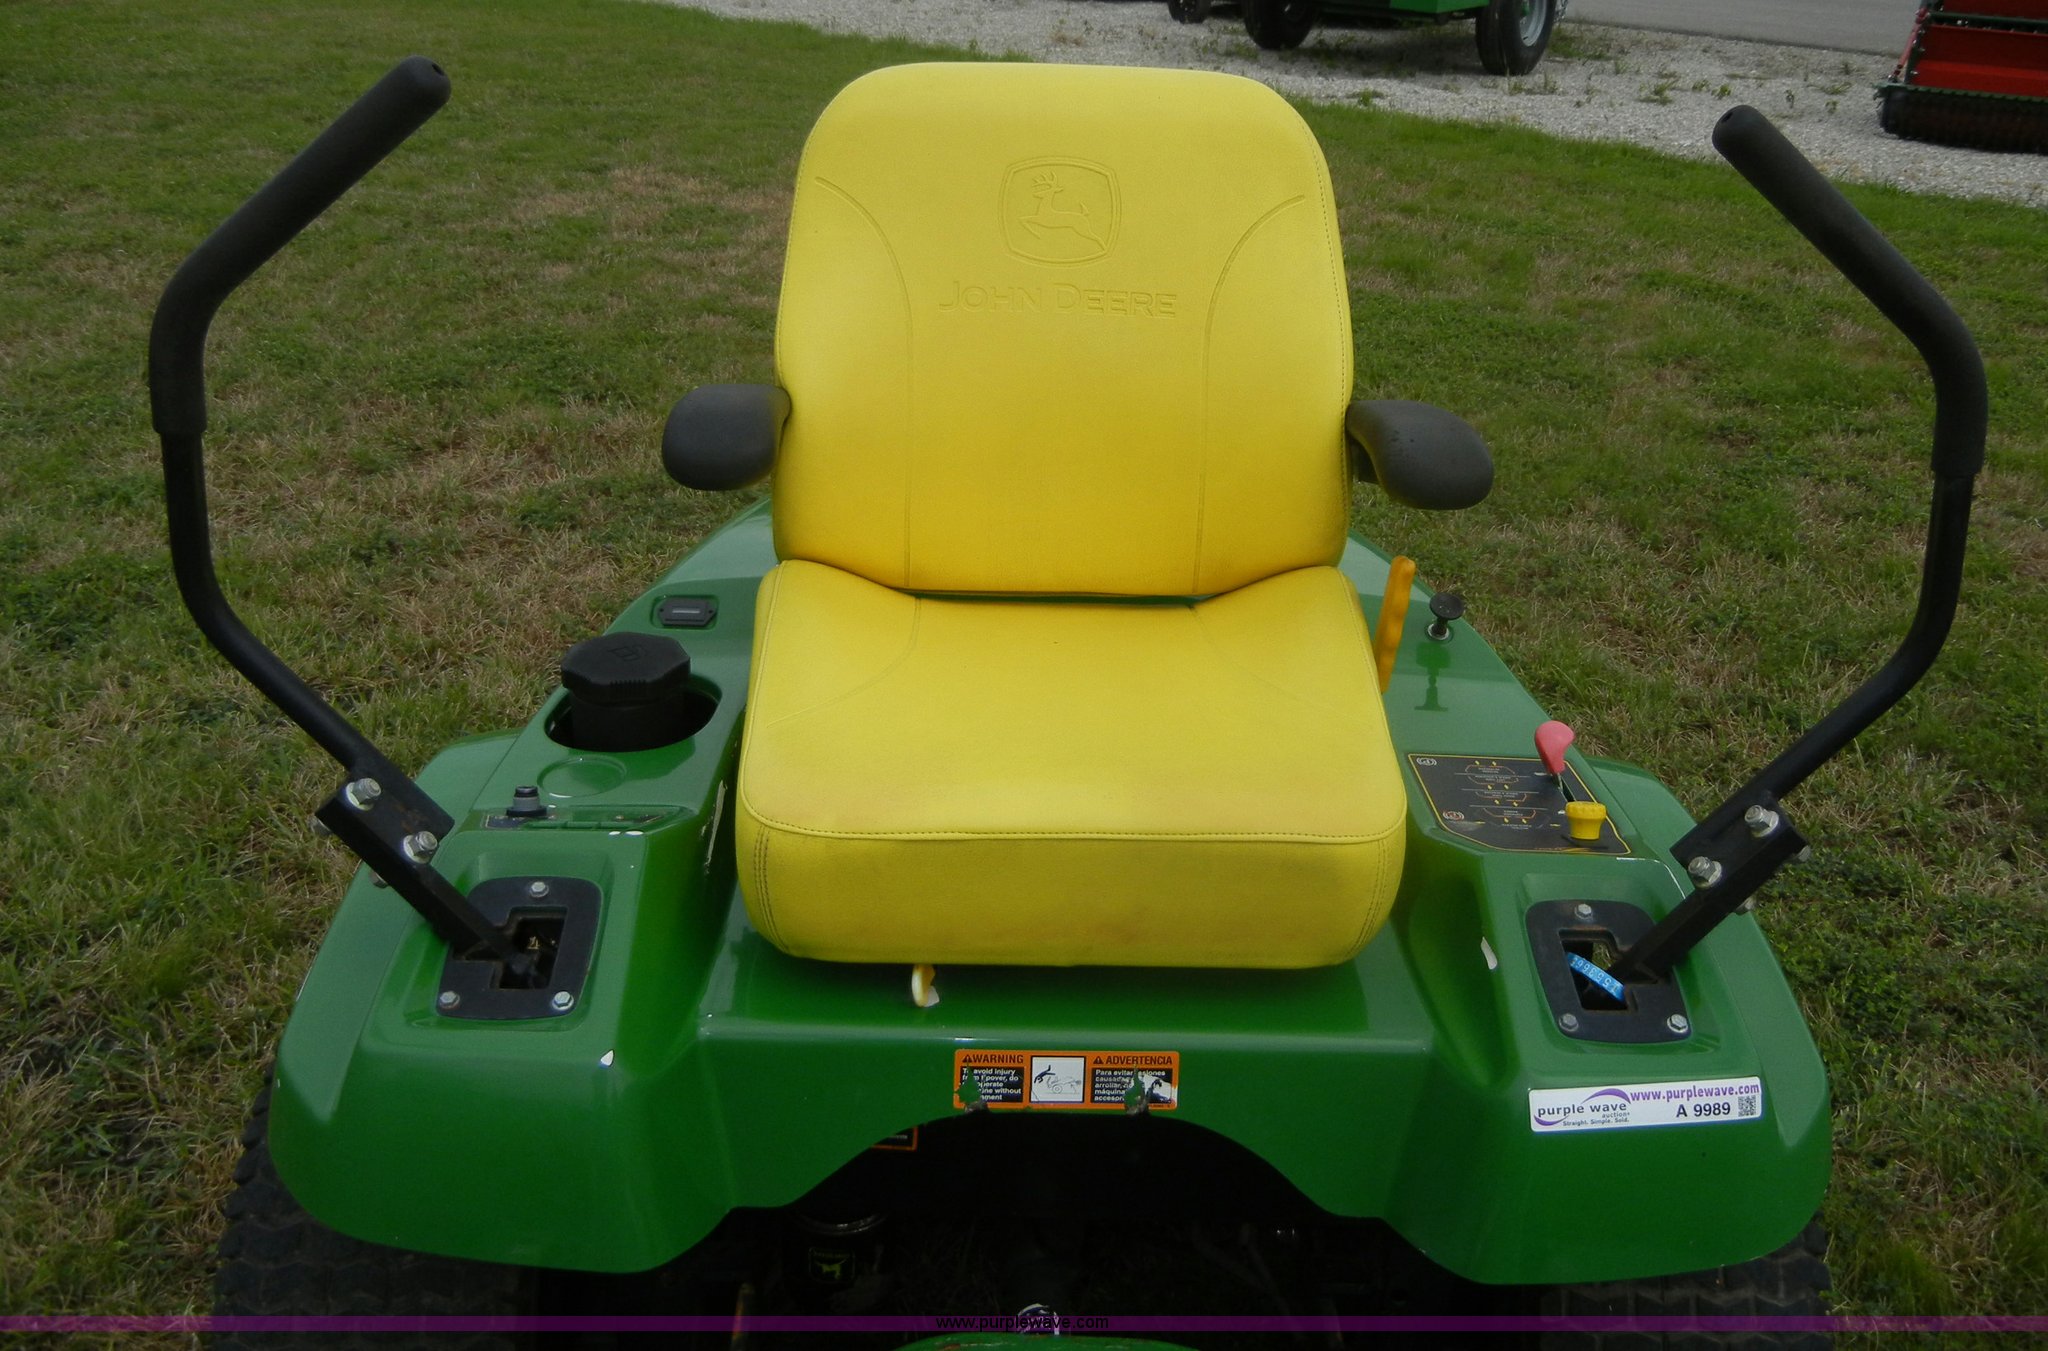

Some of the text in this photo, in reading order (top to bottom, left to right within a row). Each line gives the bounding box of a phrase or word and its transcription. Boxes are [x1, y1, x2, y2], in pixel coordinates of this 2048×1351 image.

[939, 280, 1177, 318] JOHN DEERE
[972, 1054, 1024, 1064] WARNING
[1105, 1056, 1172, 1065] ADVERTENCIA
[994, 1068, 1016, 1076] injury
[1630, 1083, 1760, 1102] www.purplewave.com
[1537, 1102, 1627, 1118] purple wave
[1676, 1102, 1731, 1118] A 9989
